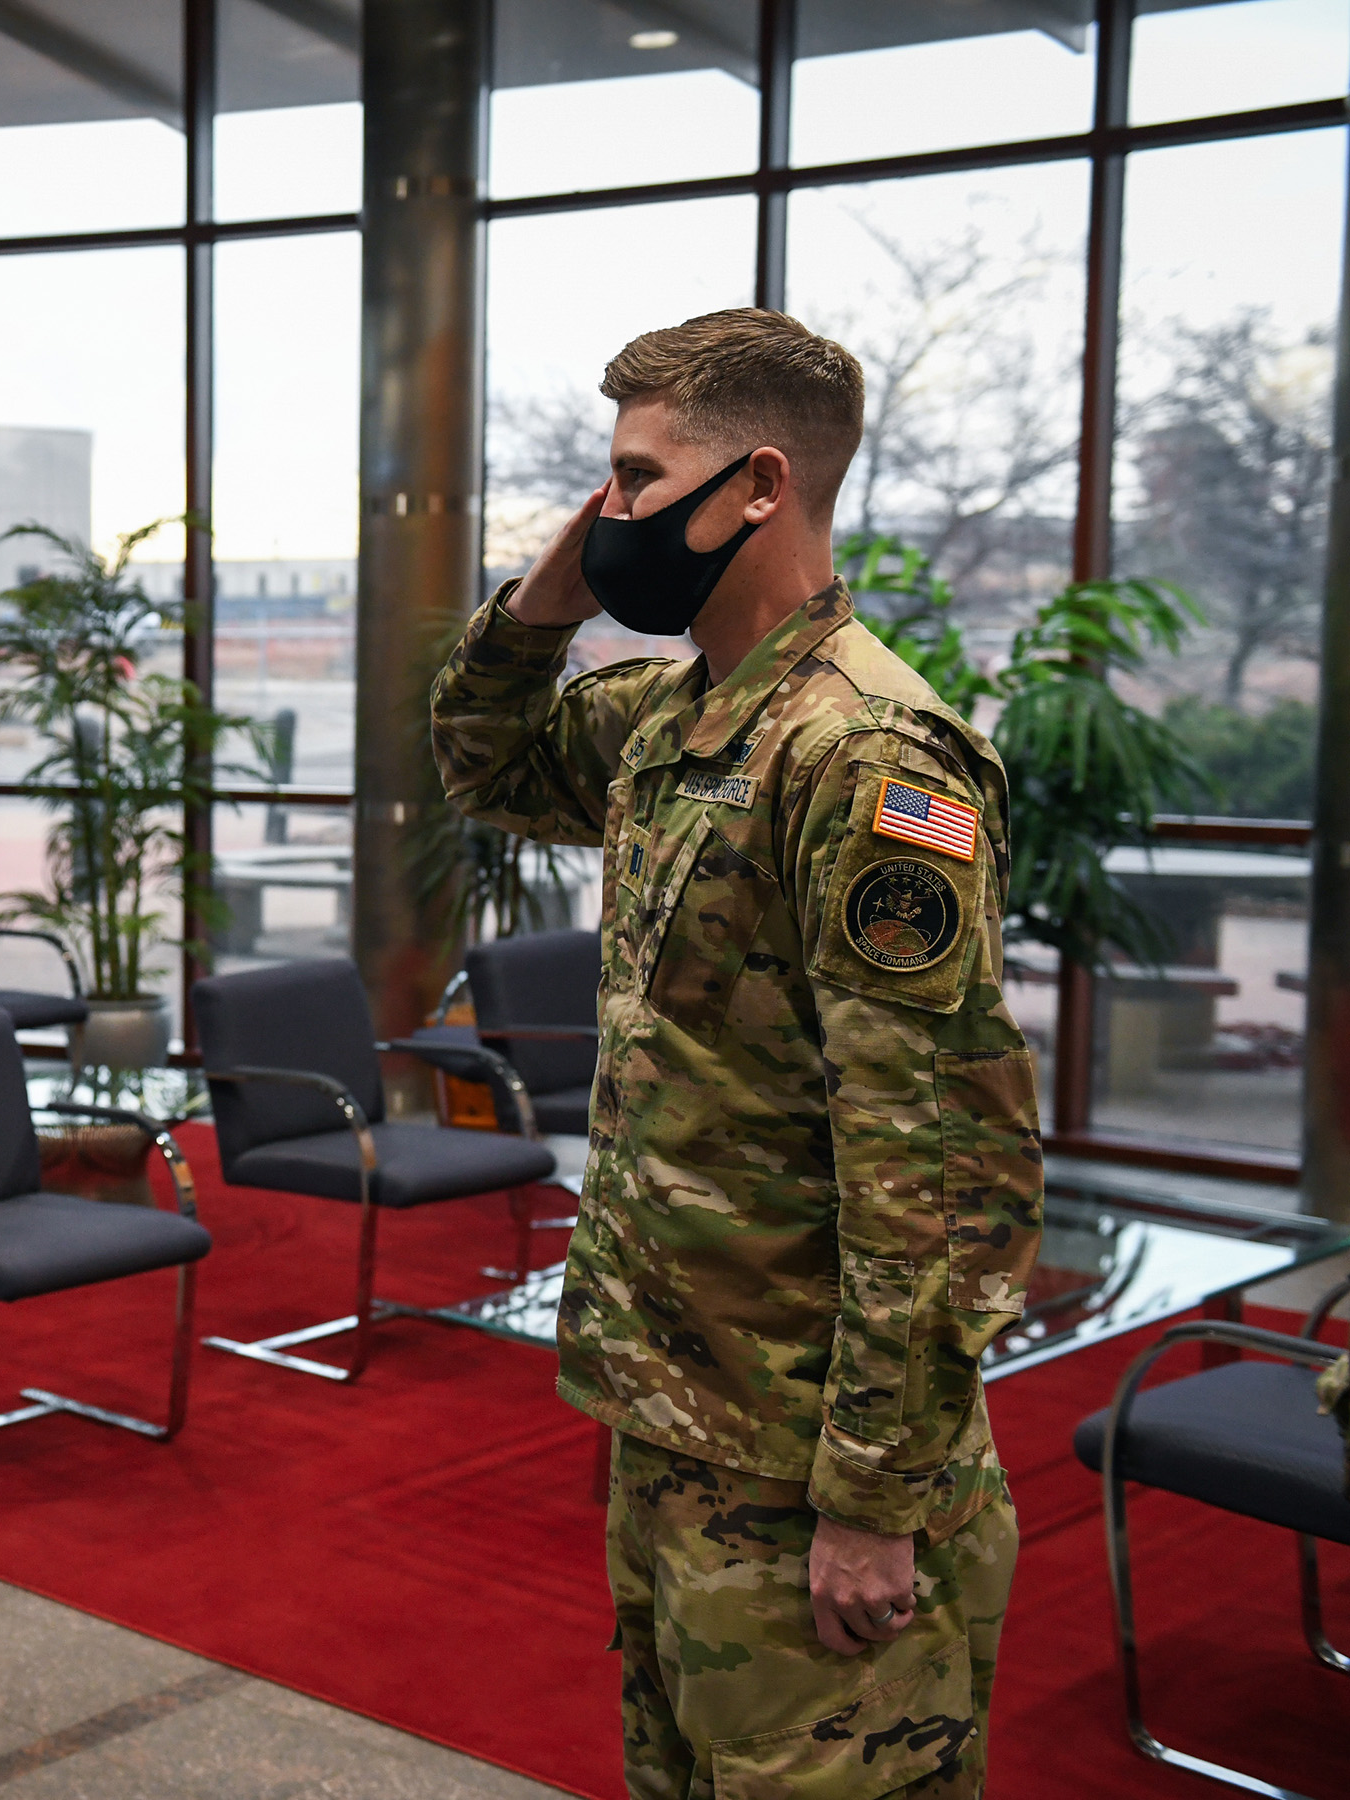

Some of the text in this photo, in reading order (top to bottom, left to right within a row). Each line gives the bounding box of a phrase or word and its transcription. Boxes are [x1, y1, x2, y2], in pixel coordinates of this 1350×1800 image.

[880, 862, 947, 892] UNITED STATES
[855, 936, 929, 967] SPACE COMMAND
